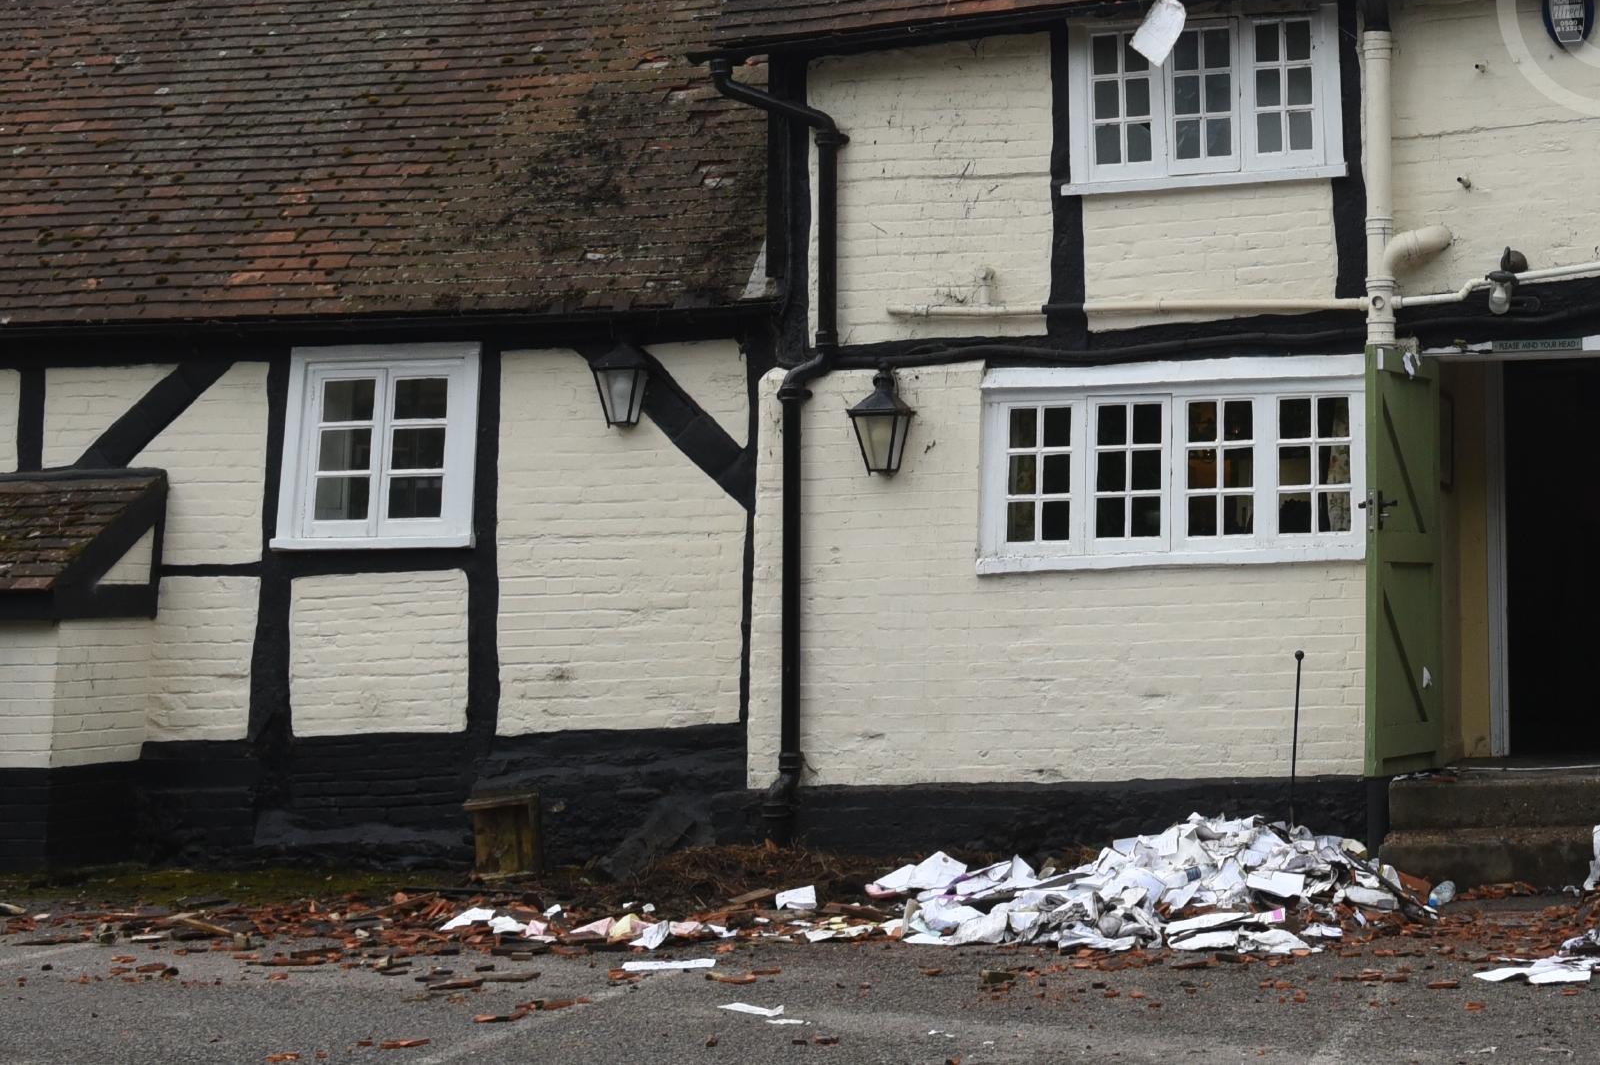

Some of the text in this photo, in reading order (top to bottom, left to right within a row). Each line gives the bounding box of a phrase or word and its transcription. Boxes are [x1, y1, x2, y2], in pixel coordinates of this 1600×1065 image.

[1499, 341, 1520, 350] PLEASE
[1521, 341, 1538, 350] MIND
[1540, 340, 1557, 349] YOUR
